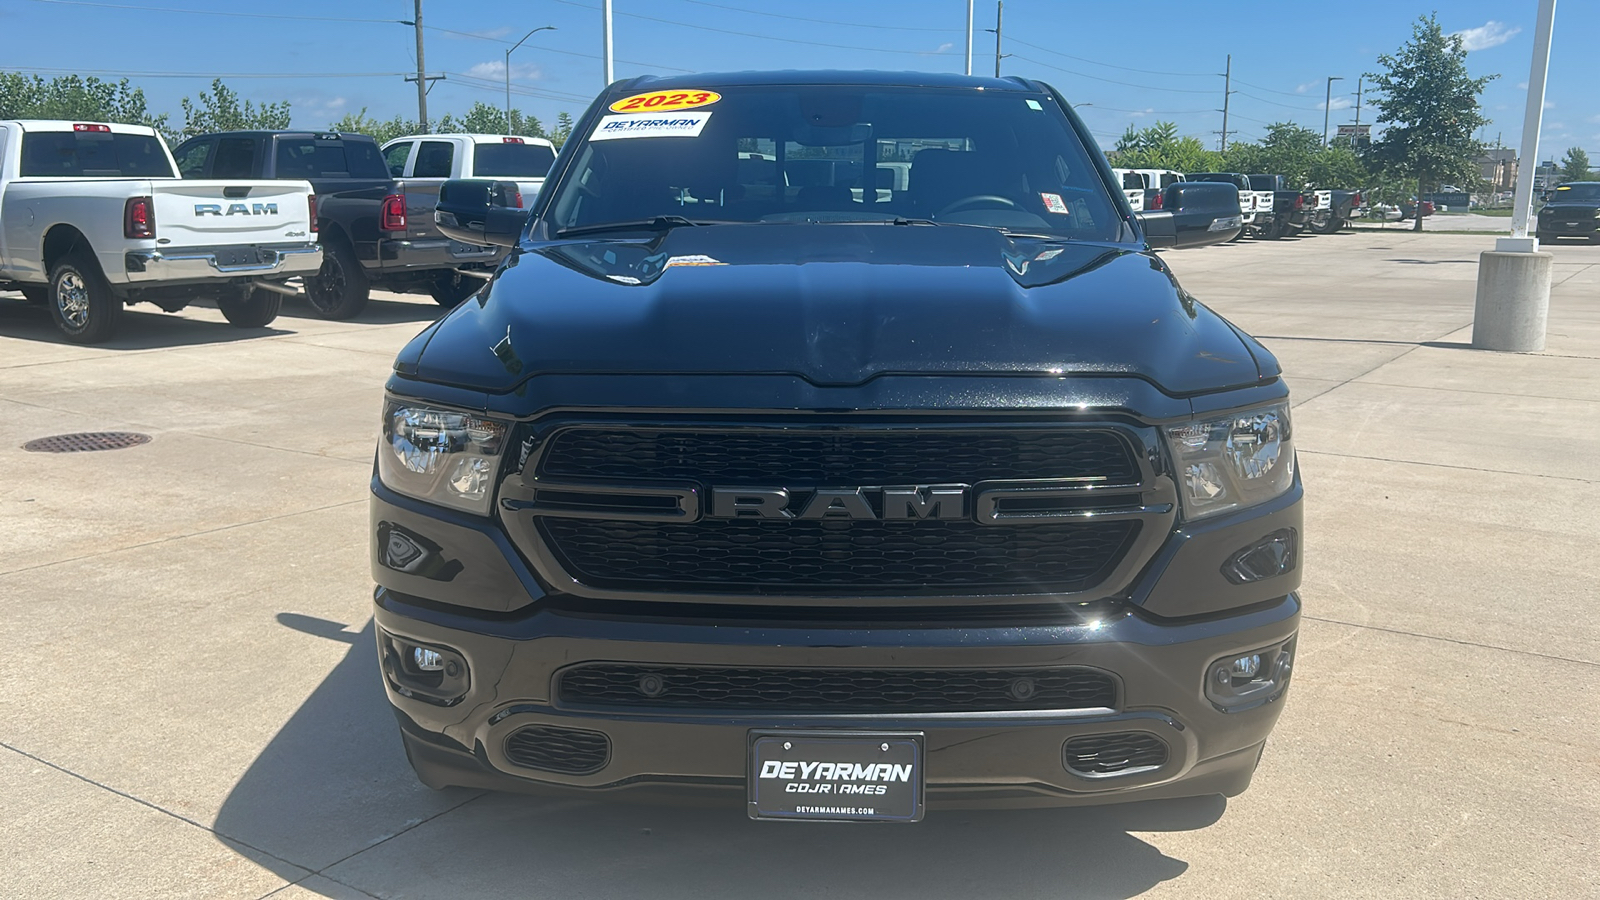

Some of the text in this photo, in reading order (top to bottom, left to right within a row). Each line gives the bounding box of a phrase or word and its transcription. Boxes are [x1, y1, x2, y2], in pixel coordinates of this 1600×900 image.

[620, 93, 711, 111] 2023
[603, 119, 701, 129] DEYARMAN
[194, 203, 279, 217] RAM
[712, 486, 966, 520] RAM
[759, 760, 913, 783] DEYARMAN
[785, 783, 888, 795] CDJR AMES
[796, 806, 875, 815] DEYARMANAMES.COM
